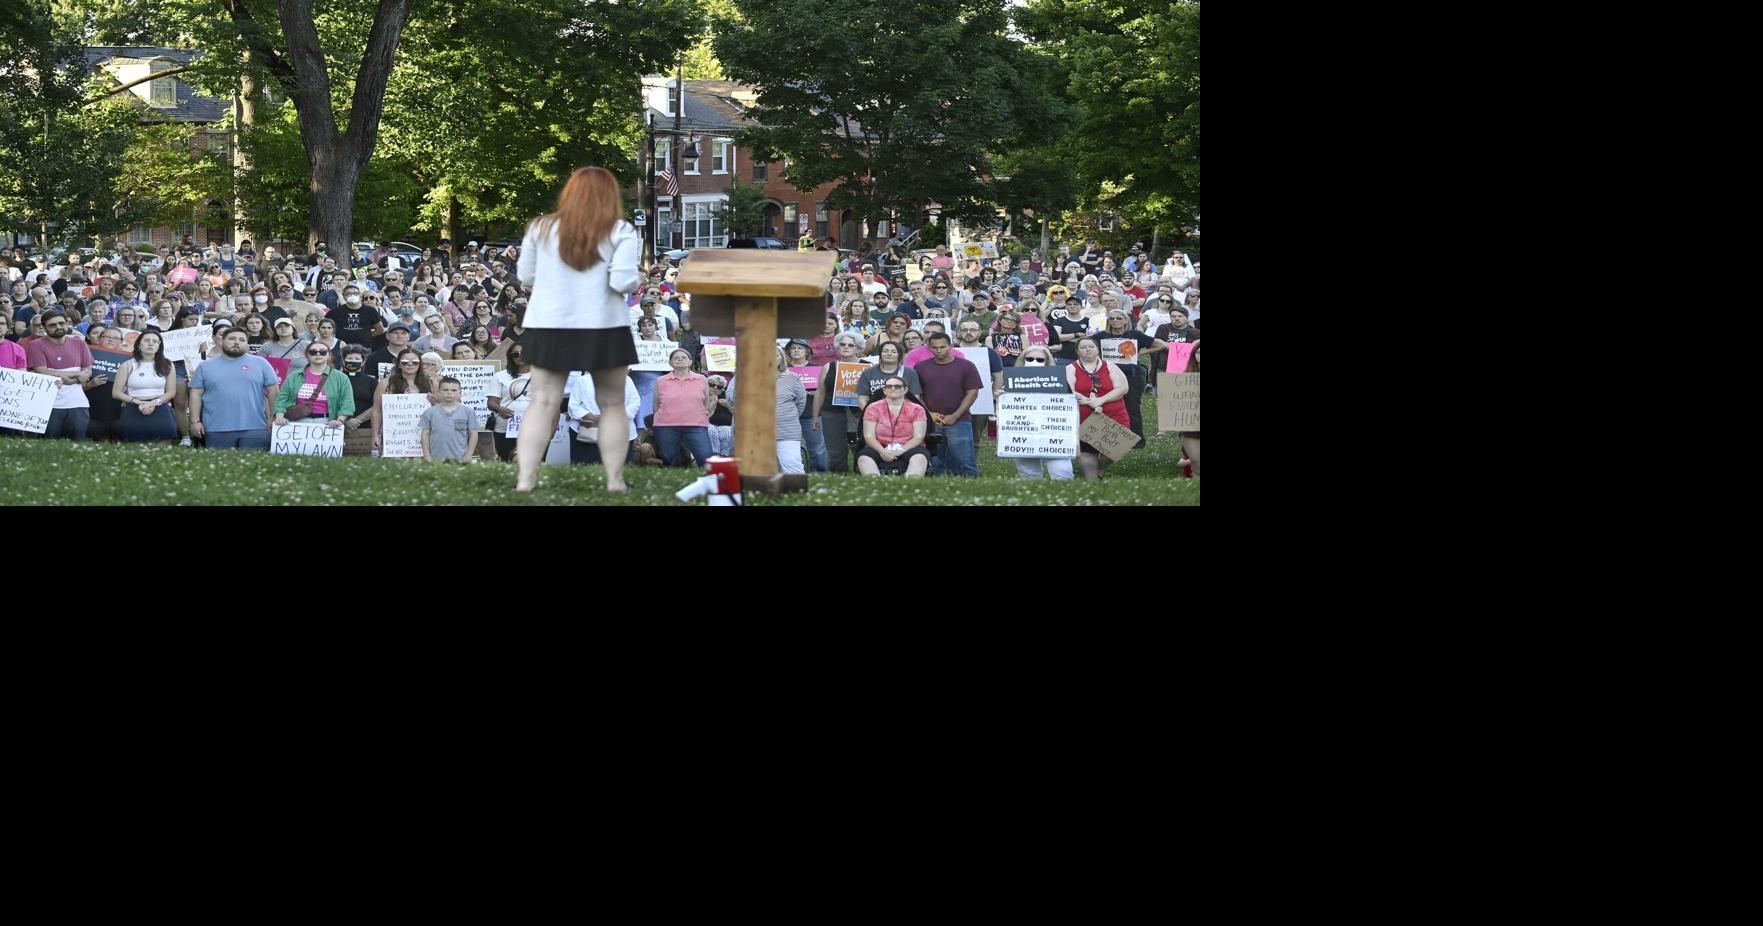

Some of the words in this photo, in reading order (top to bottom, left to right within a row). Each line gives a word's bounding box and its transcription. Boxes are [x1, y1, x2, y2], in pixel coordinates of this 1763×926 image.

[1020, 323, 1043, 338] TE
[870, 379, 886, 387] BAN
[276, 425, 309, 440] GET
[312, 426, 342, 441] OFF
[276, 442, 301, 456] MY
